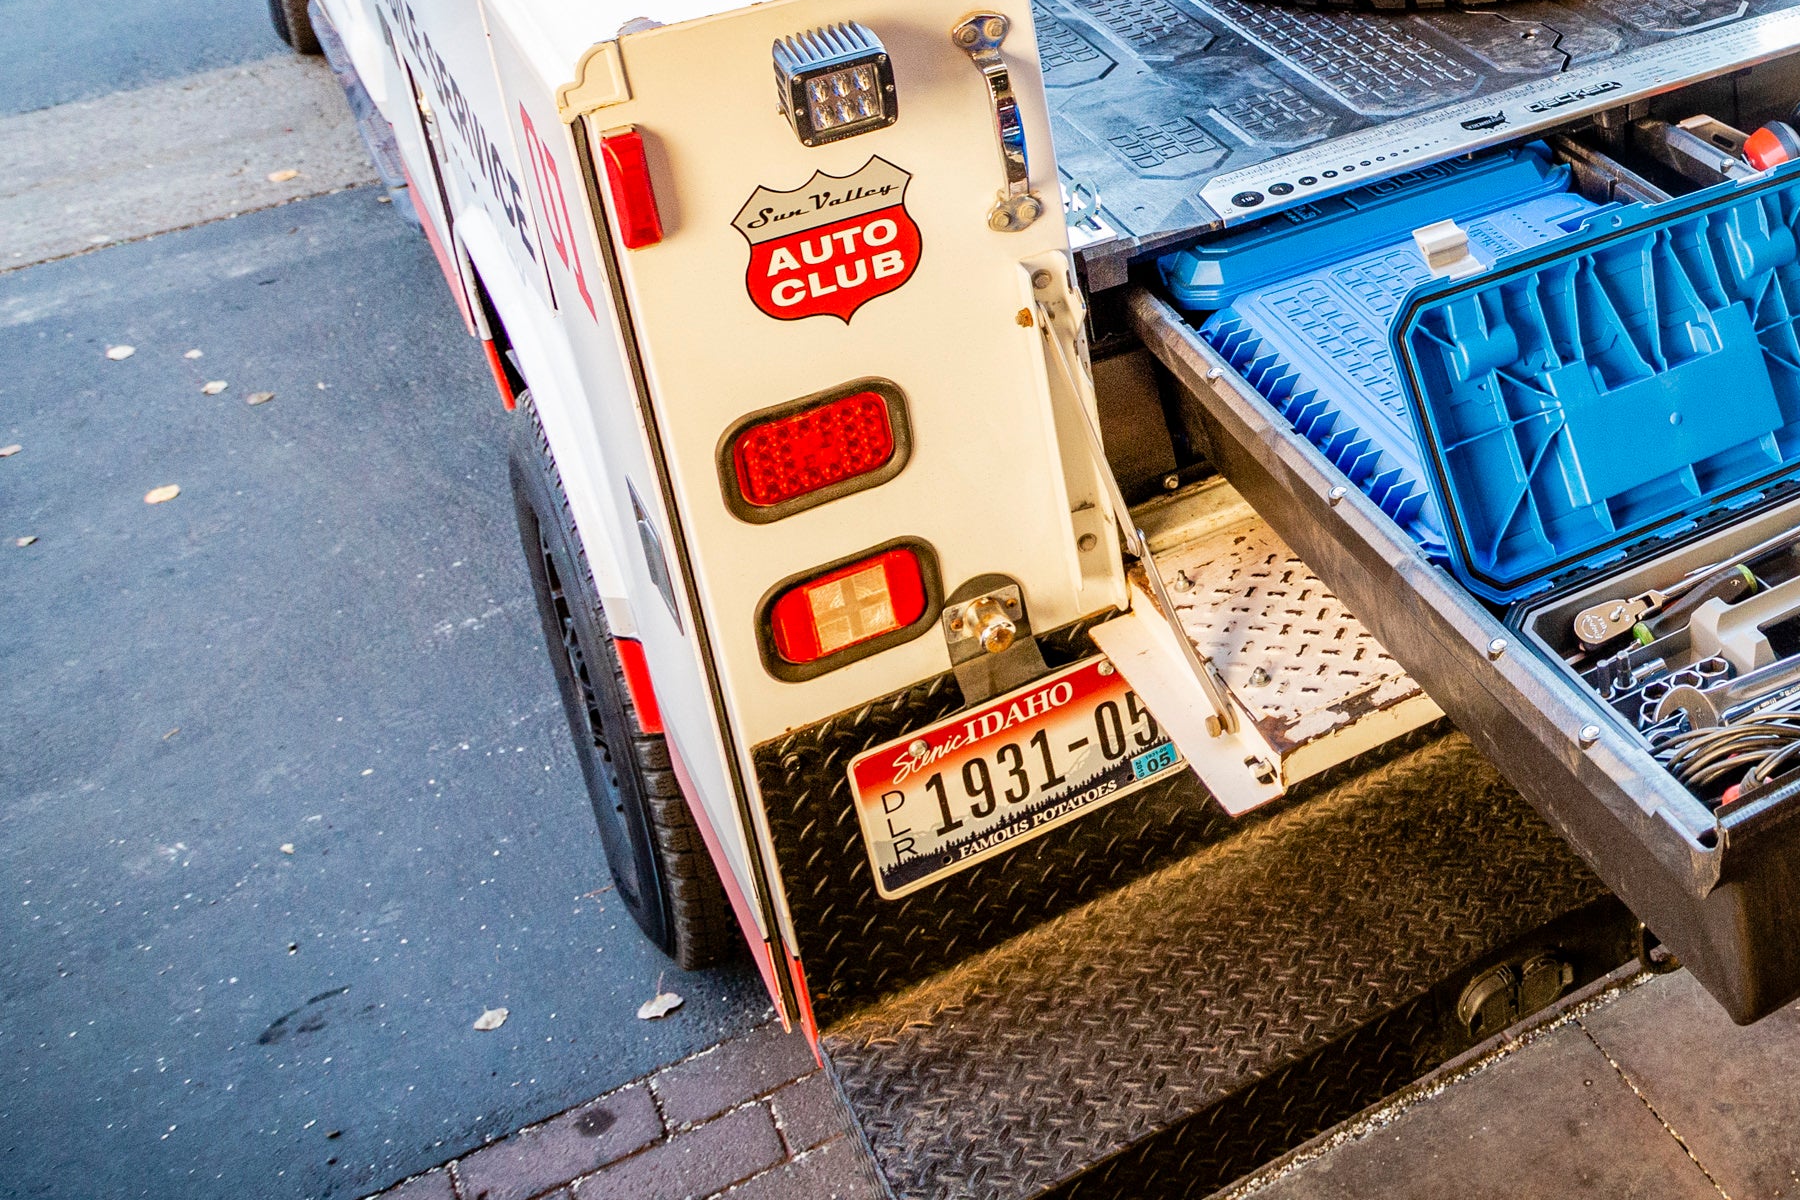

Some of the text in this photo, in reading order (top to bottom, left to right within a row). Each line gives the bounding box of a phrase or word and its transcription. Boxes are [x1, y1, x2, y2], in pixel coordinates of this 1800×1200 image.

[1523, 81, 1623, 112] DECKED
[423, 31, 537, 264] SERVICE
[747, 184, 900, 229] Sun Valley
[766, 218, 898, 277] AUTO
[771, 249, 906, 307] CLUB
[891, 681, 1074, 785] Scenic IDAHO
[1147, 751, 1171, 773] 05
[925, 690, 1160, 838] 1931-05
[1136, 760, 1145, 778] 2019
[958, 779, 1118, 860] FAMOUS POTATOES
